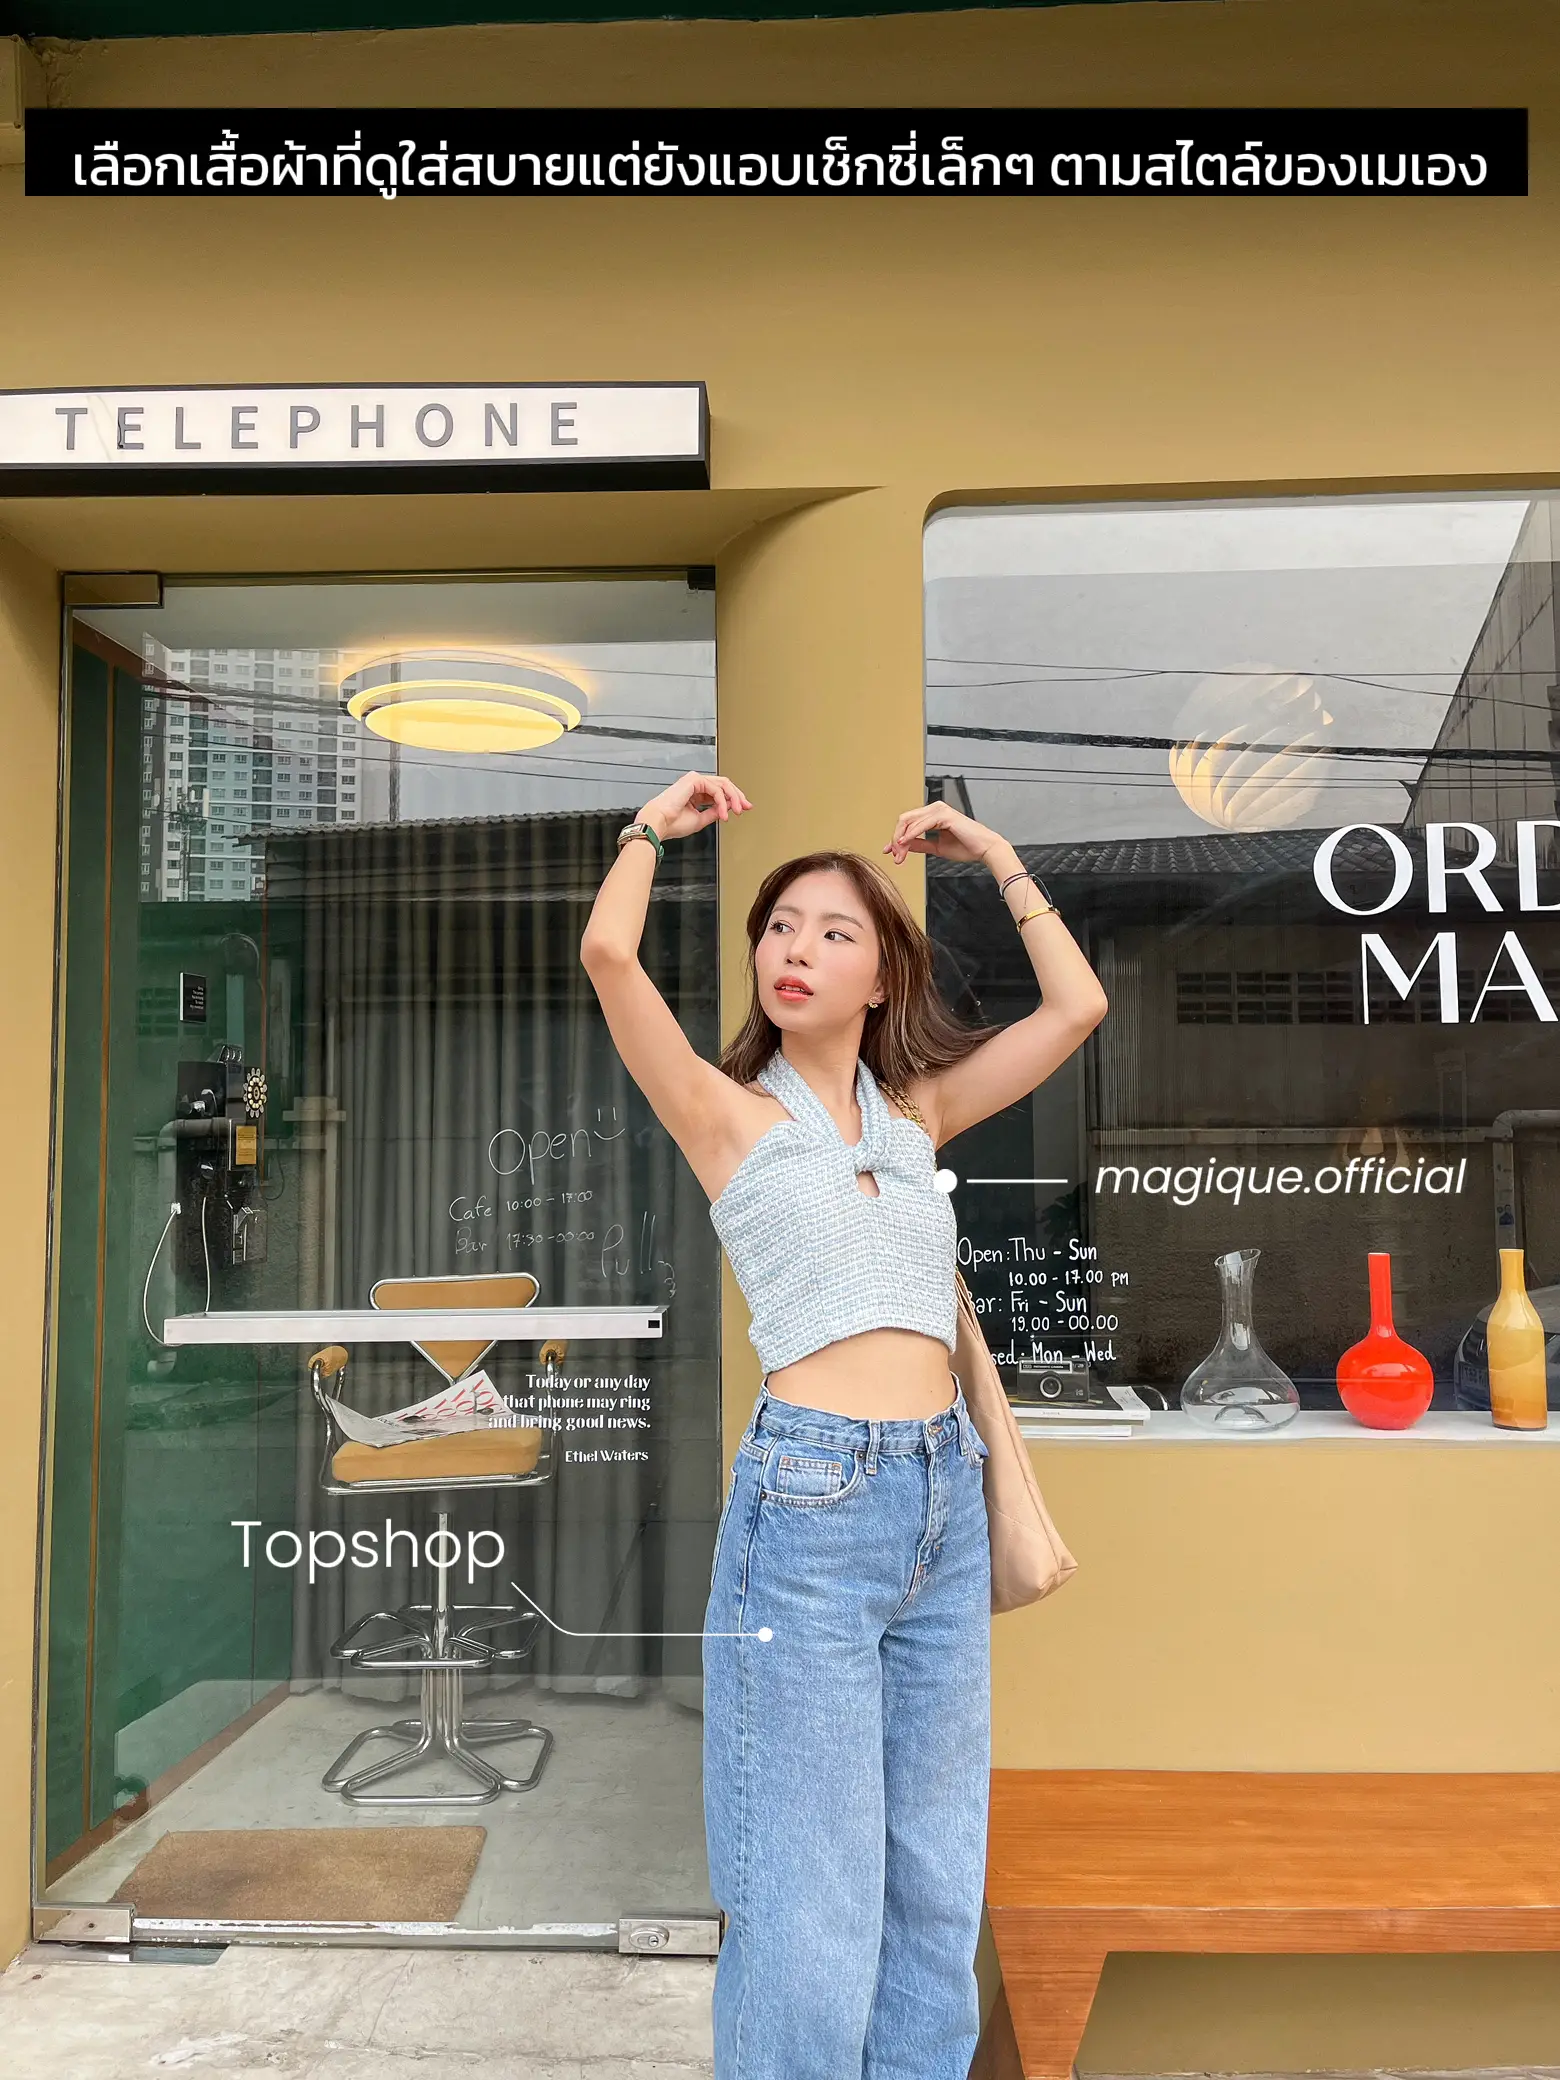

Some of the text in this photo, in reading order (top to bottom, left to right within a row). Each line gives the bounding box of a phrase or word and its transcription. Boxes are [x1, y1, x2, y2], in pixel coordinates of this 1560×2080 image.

[55, 402, 578, 451] TELEPHONE
[1360, 930, 1559, 1025] MA
[488, 1128, 592, 1185] Open
[449, 1195, 493, 1222] Cafe
[506, 1197, 542, 1212] 10:00
[561, 1190, 593, 1204] 17:00
[455, 1227, 488, 1255] Bar
[1009, 1237, 1046, 1262] Thu
[1068, 1238, 1098, 1261] Sun
[1009, 1271, 1047, 1287] 10.00
[1065, 1270, 1103, 1285] 17.00
[1112, 1272, 1129, 1287] PM
[1010, 1290, 1029, 1312] Fri
[1056, 1290, 1087, 1313] Sun
[1011, 1316, 1050, 1332] 19.00
[1068, 1314, 1119, 1331] 00.00
[1032, 1341, 1063, 1365] Mon
[1084, 1340, 1117, 1362] Wed
[525, 1374, 651, 1391] Today or any day
[503, 1395, 651, 1414] that phone may ring
[488, 1414, 651, 1431] and bring good news.
[565, 1448, 649, 1463] Ethel Waters
